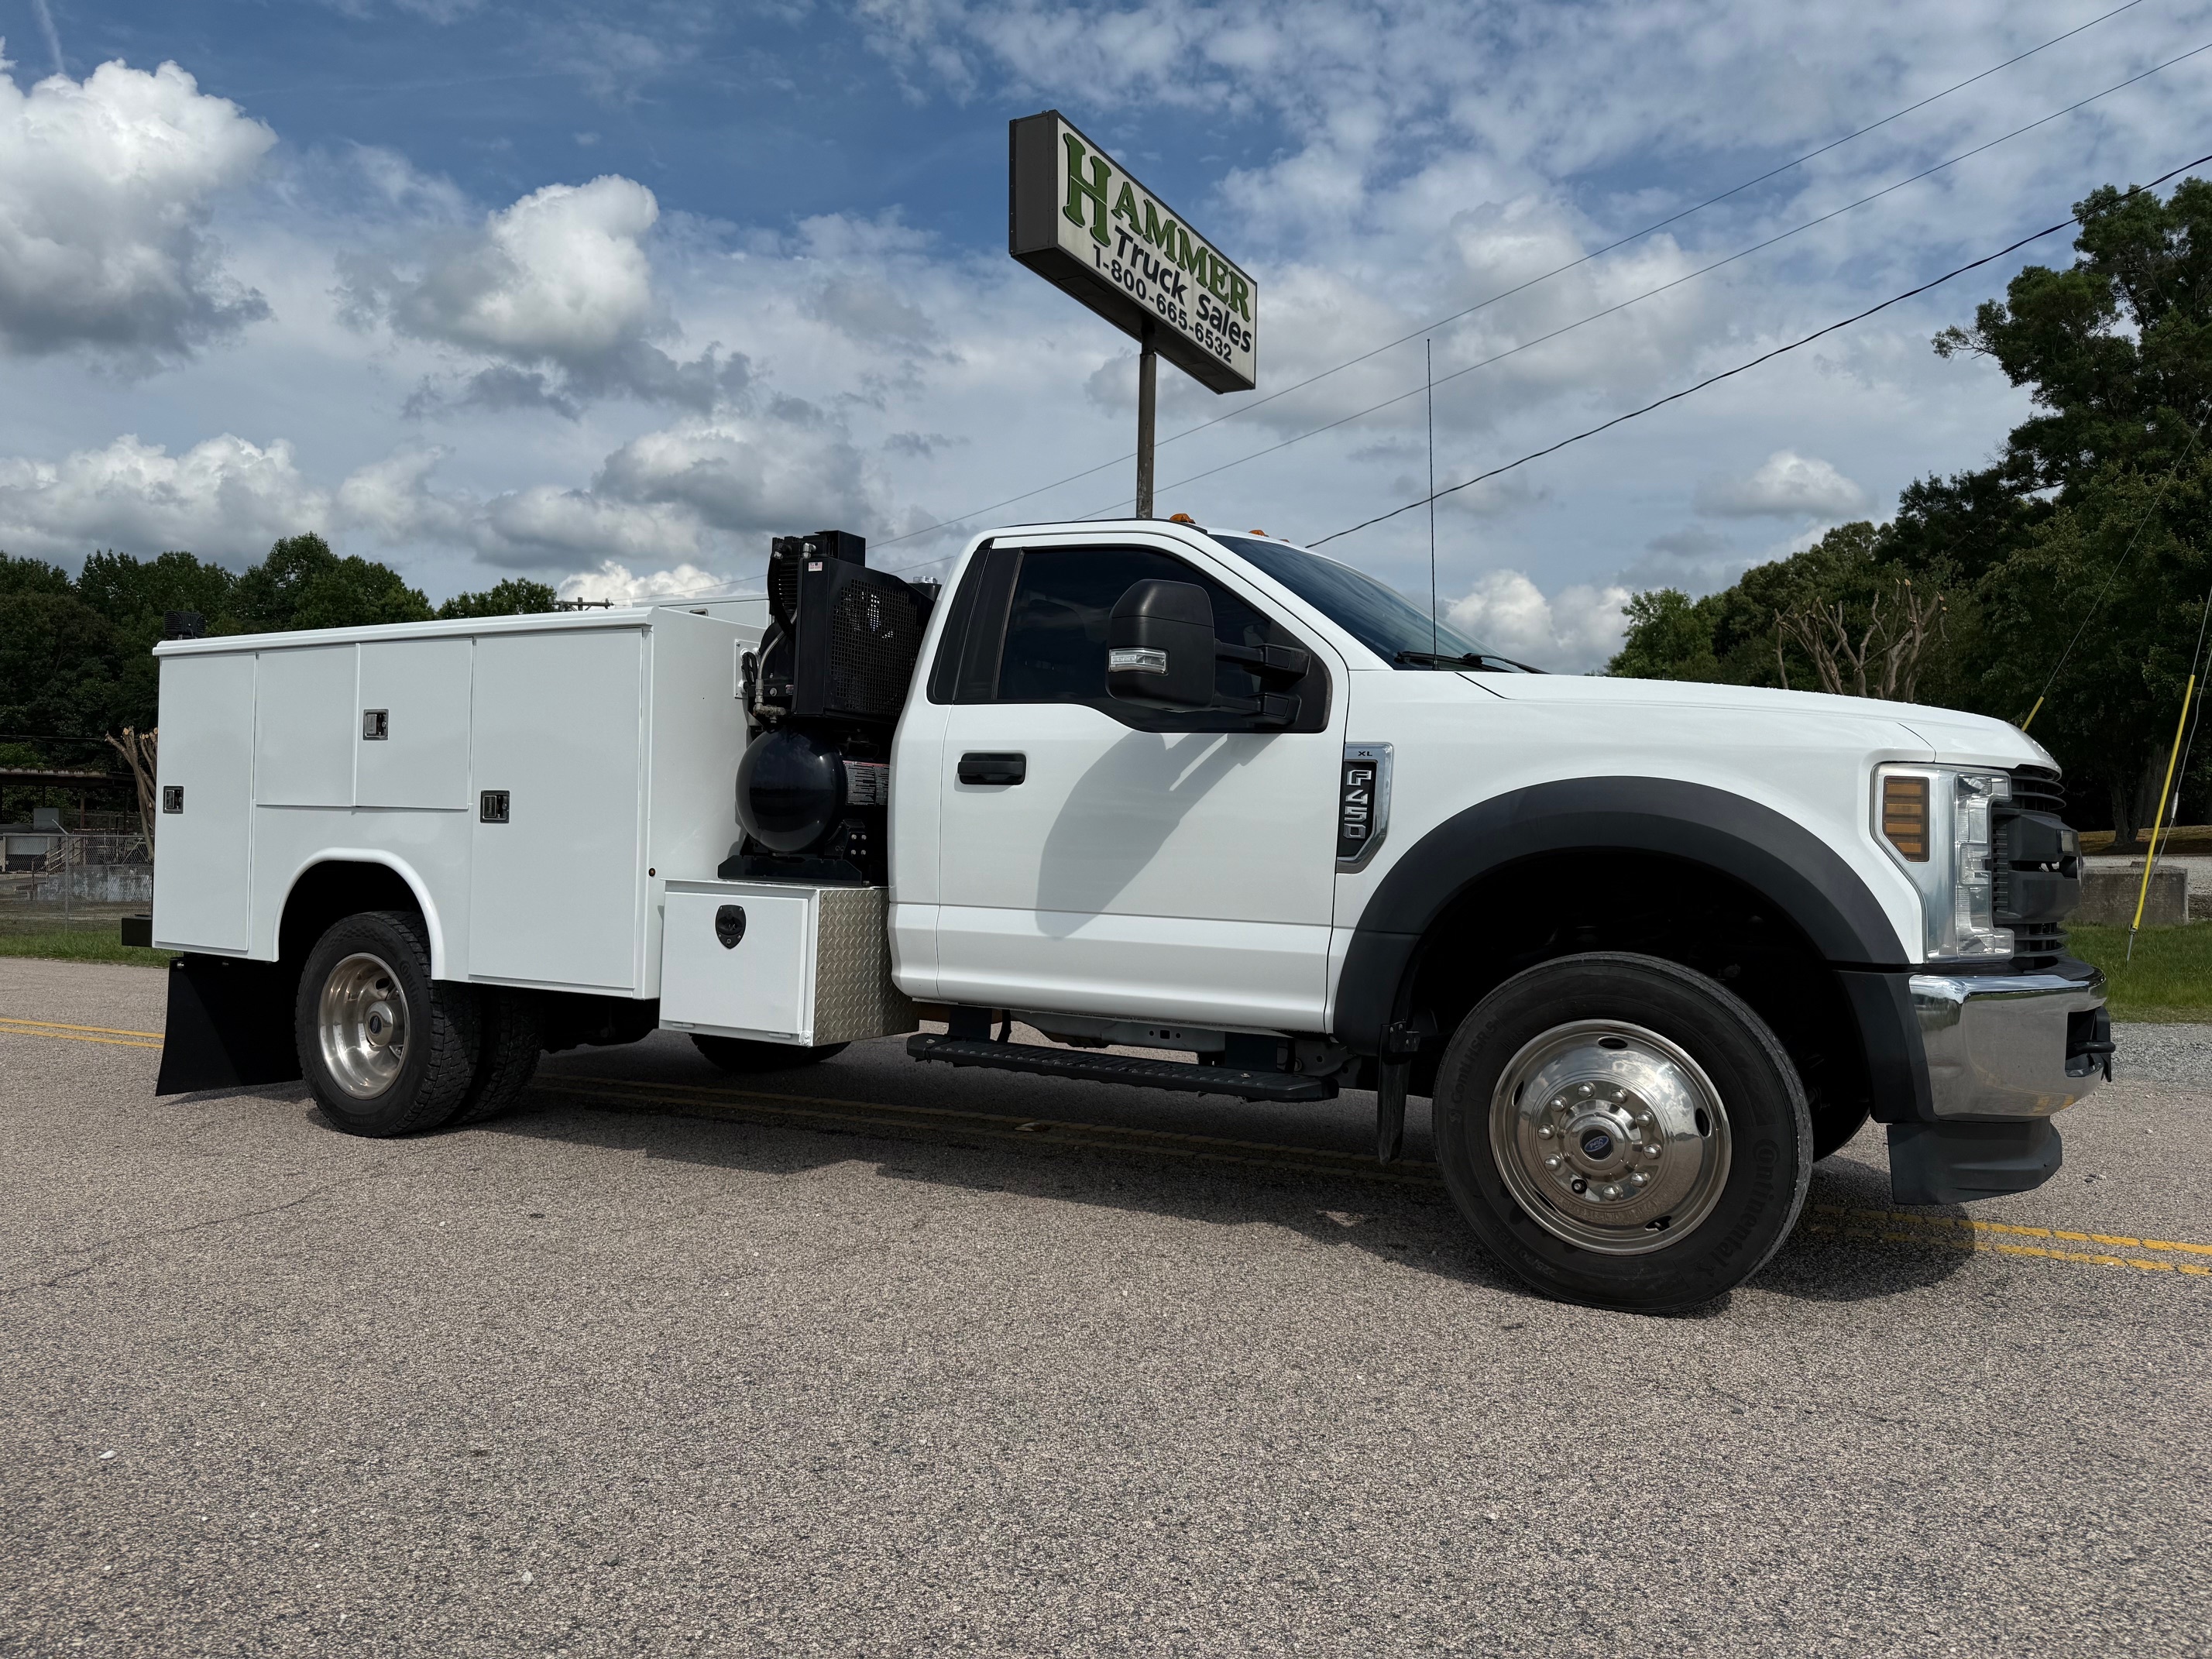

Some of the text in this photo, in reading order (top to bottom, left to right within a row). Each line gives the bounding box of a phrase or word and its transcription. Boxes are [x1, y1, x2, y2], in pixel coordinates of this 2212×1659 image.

[1063, 132, 1251, 322] HAMMER
[1115, 225, 1252, 353] Truck Sales
[1092, 244, 1232, 364] 1-800-665-6532
[1710, 1139, 1781, 1268] Continental
